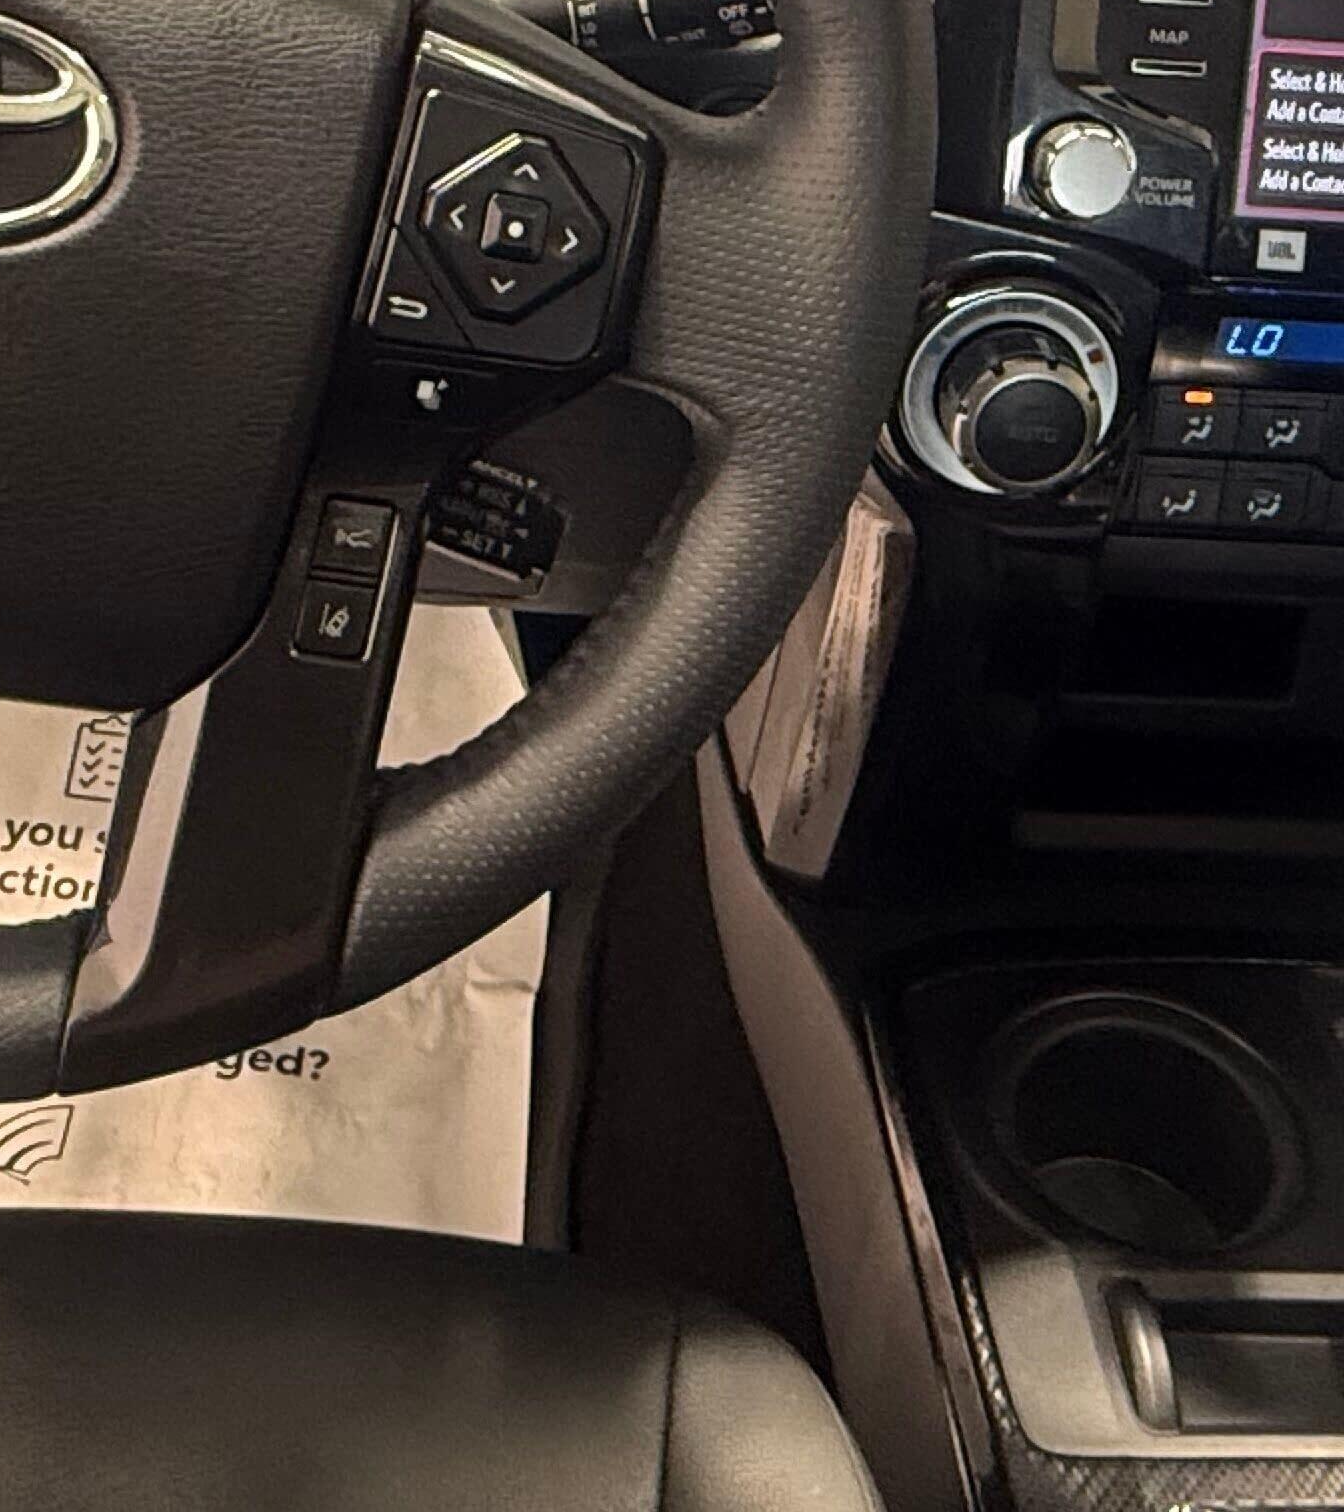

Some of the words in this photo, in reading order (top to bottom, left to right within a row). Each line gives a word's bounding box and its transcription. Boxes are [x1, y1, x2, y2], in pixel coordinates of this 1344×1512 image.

[1148, 28, 1190, 45] MAP
[1270, 68, 1311, 92] Select
[1314, 71, 1326, 92] &
[1266, 99, 1294, 121] Add
[1262, 138, 1304, 161] Select
[1307, 141, 1319, 163] &
[1140, 176, 1192, 192] POWER
[1258, 169, 1287, 191] Add
[1135, 190, 1196, 208] VOLUME
[1226, 323, 1283, 358] LO
[0, 818, 84, 852] you
